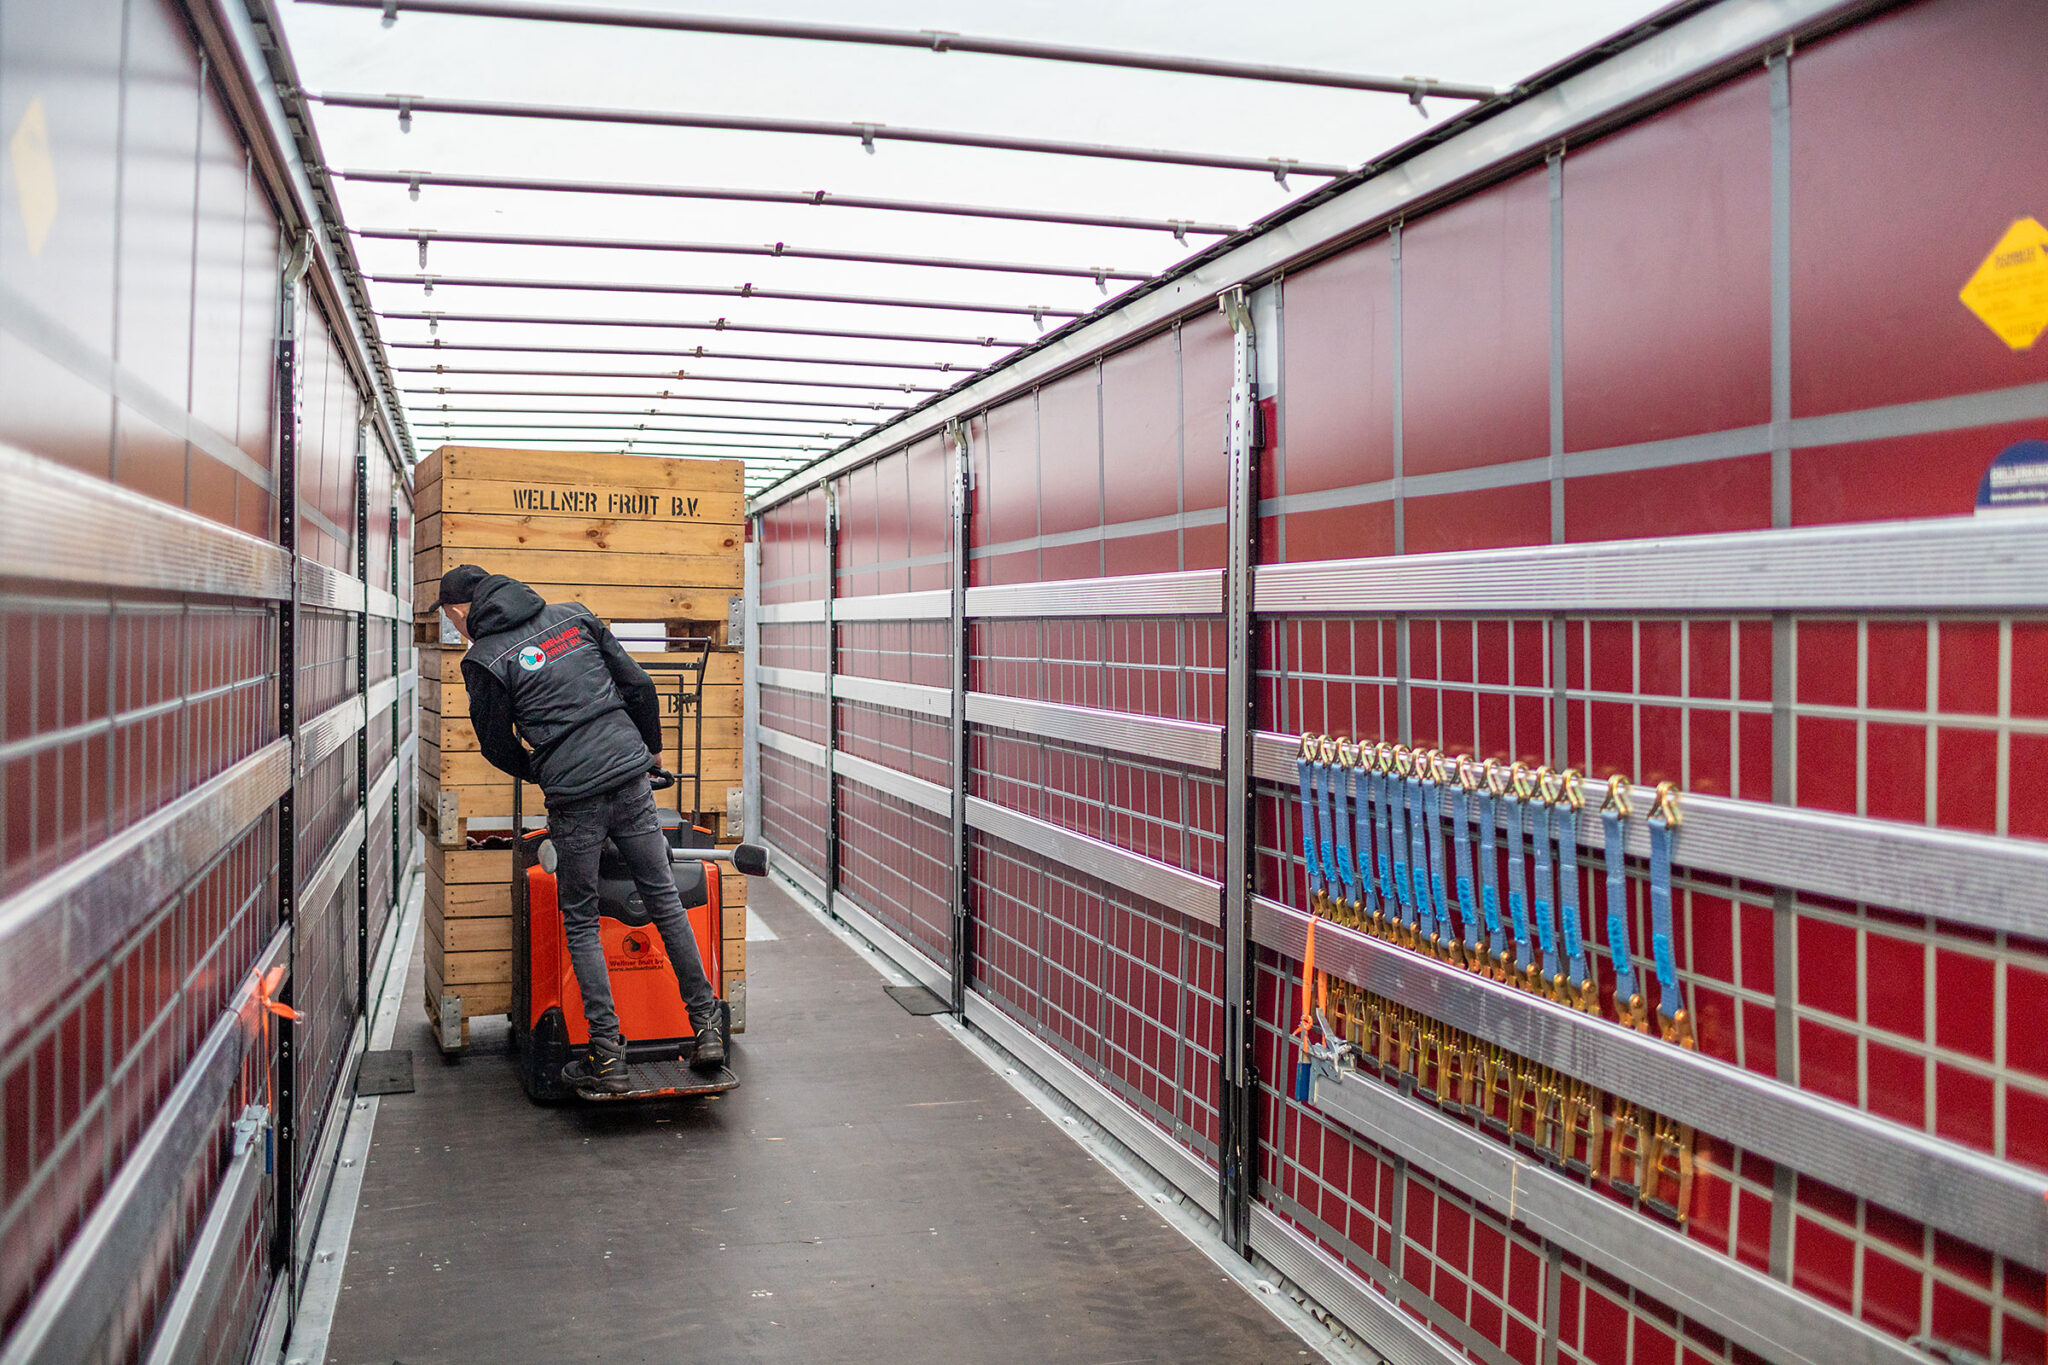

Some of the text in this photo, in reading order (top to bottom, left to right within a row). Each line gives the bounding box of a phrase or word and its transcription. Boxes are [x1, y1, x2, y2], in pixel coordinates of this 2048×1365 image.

[513, 489, 701, 517] WELLNER FRUIT B.V.
[538, 626, 580, 651] WELLNER
[545, 636, 581, 658] FRUIT BV
